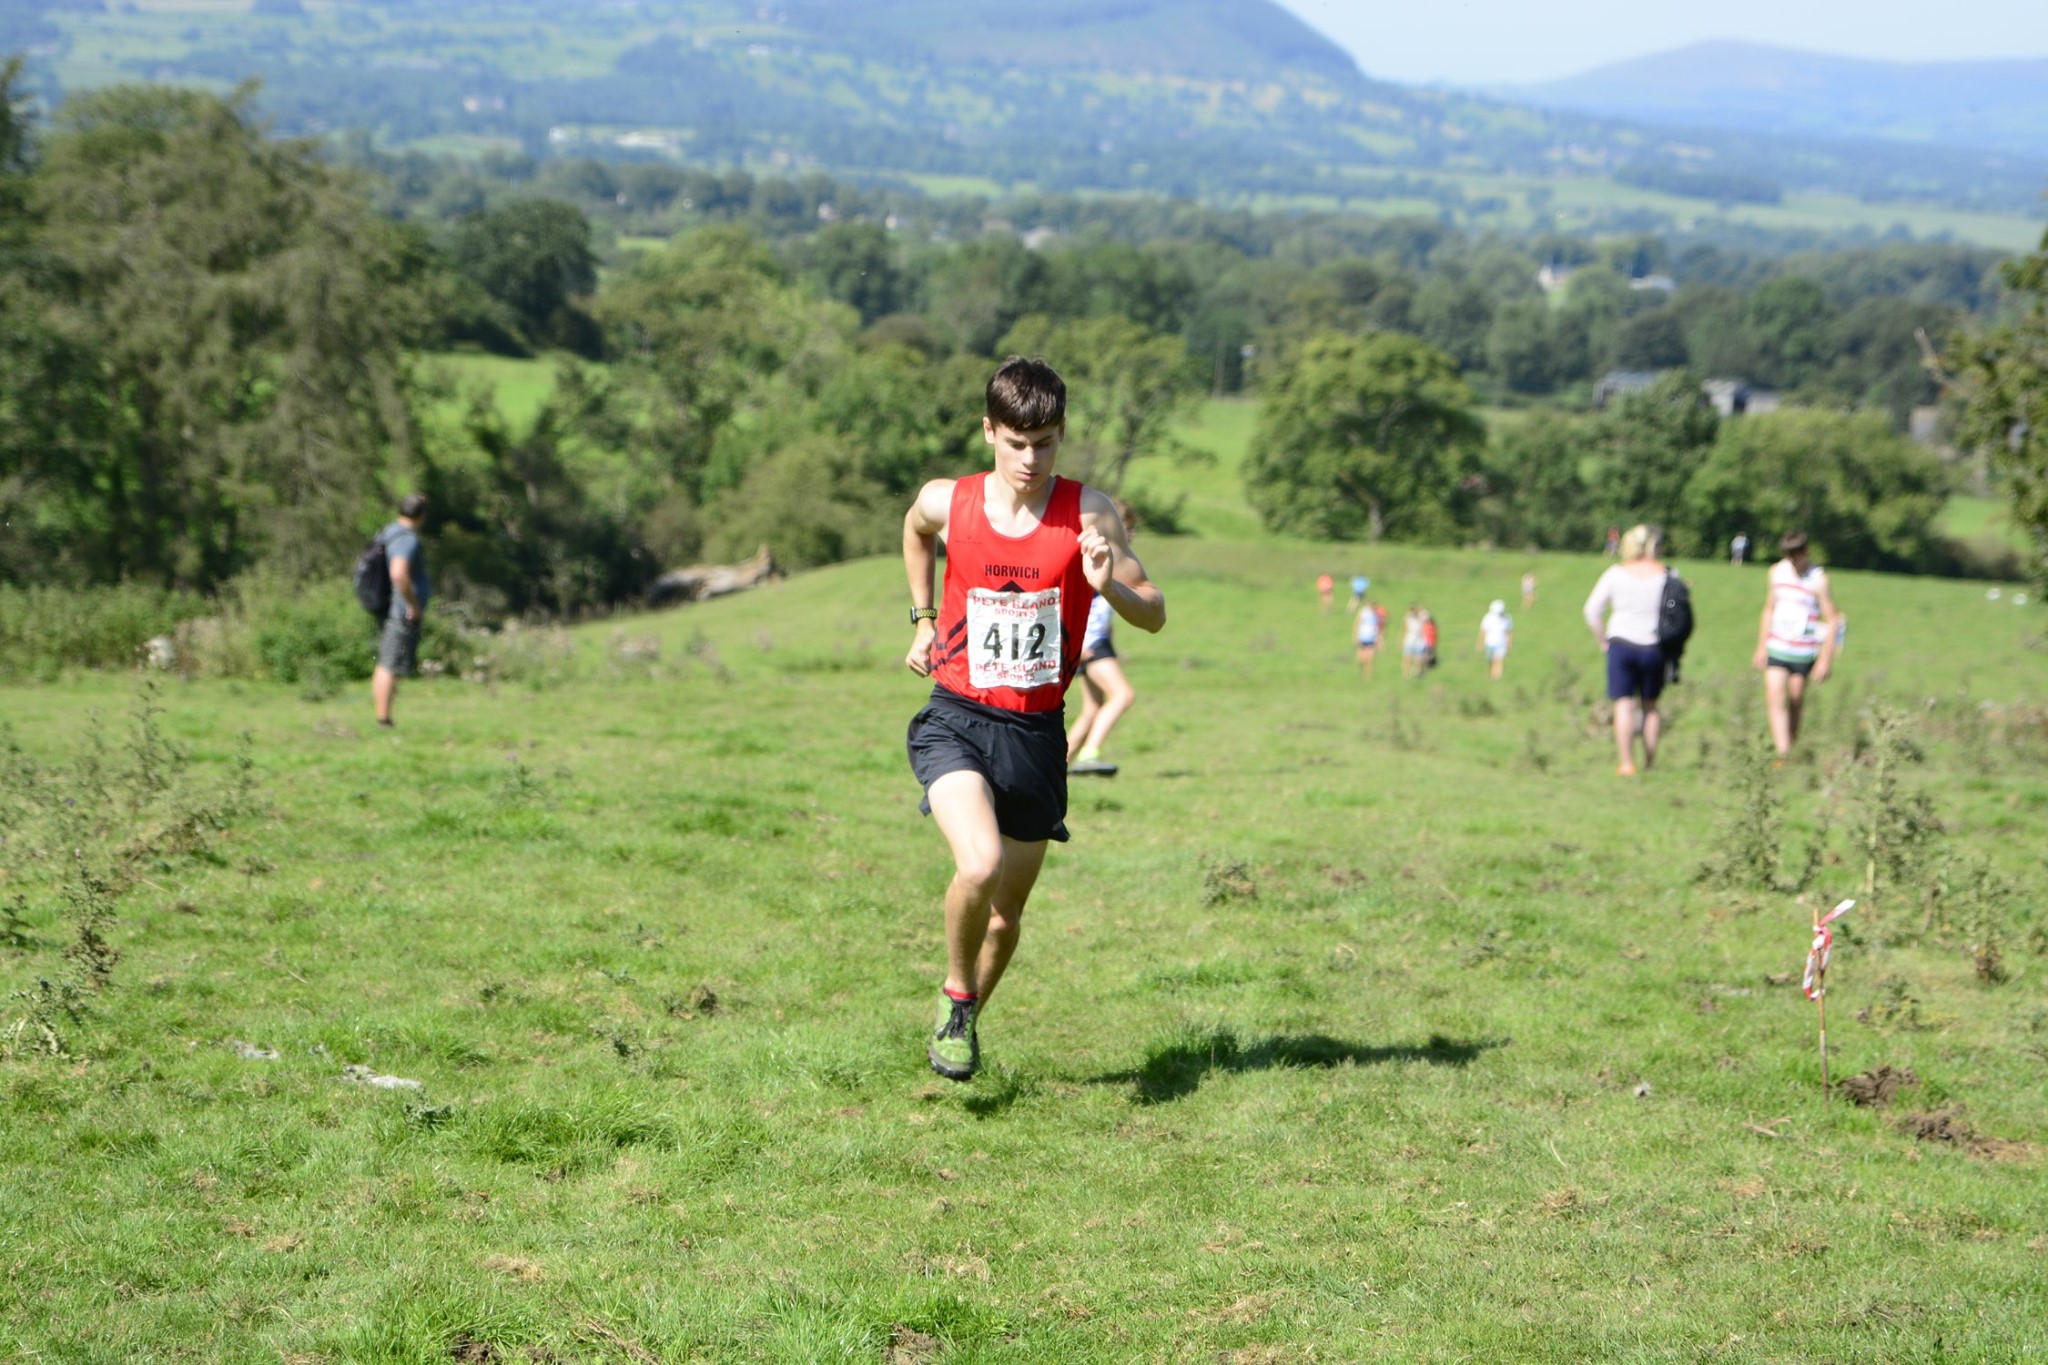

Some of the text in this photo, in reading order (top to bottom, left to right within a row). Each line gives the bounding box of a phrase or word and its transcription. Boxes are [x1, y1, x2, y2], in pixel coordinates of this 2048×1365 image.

[985, 564, 1039, 579] HORWICH
[973, 595, 1008, 607] PETE
[994, 608, 1036, 619] SPORTS
[983, 622, 1046, 661] 412
[975, 661, 1009, 672] PETE
